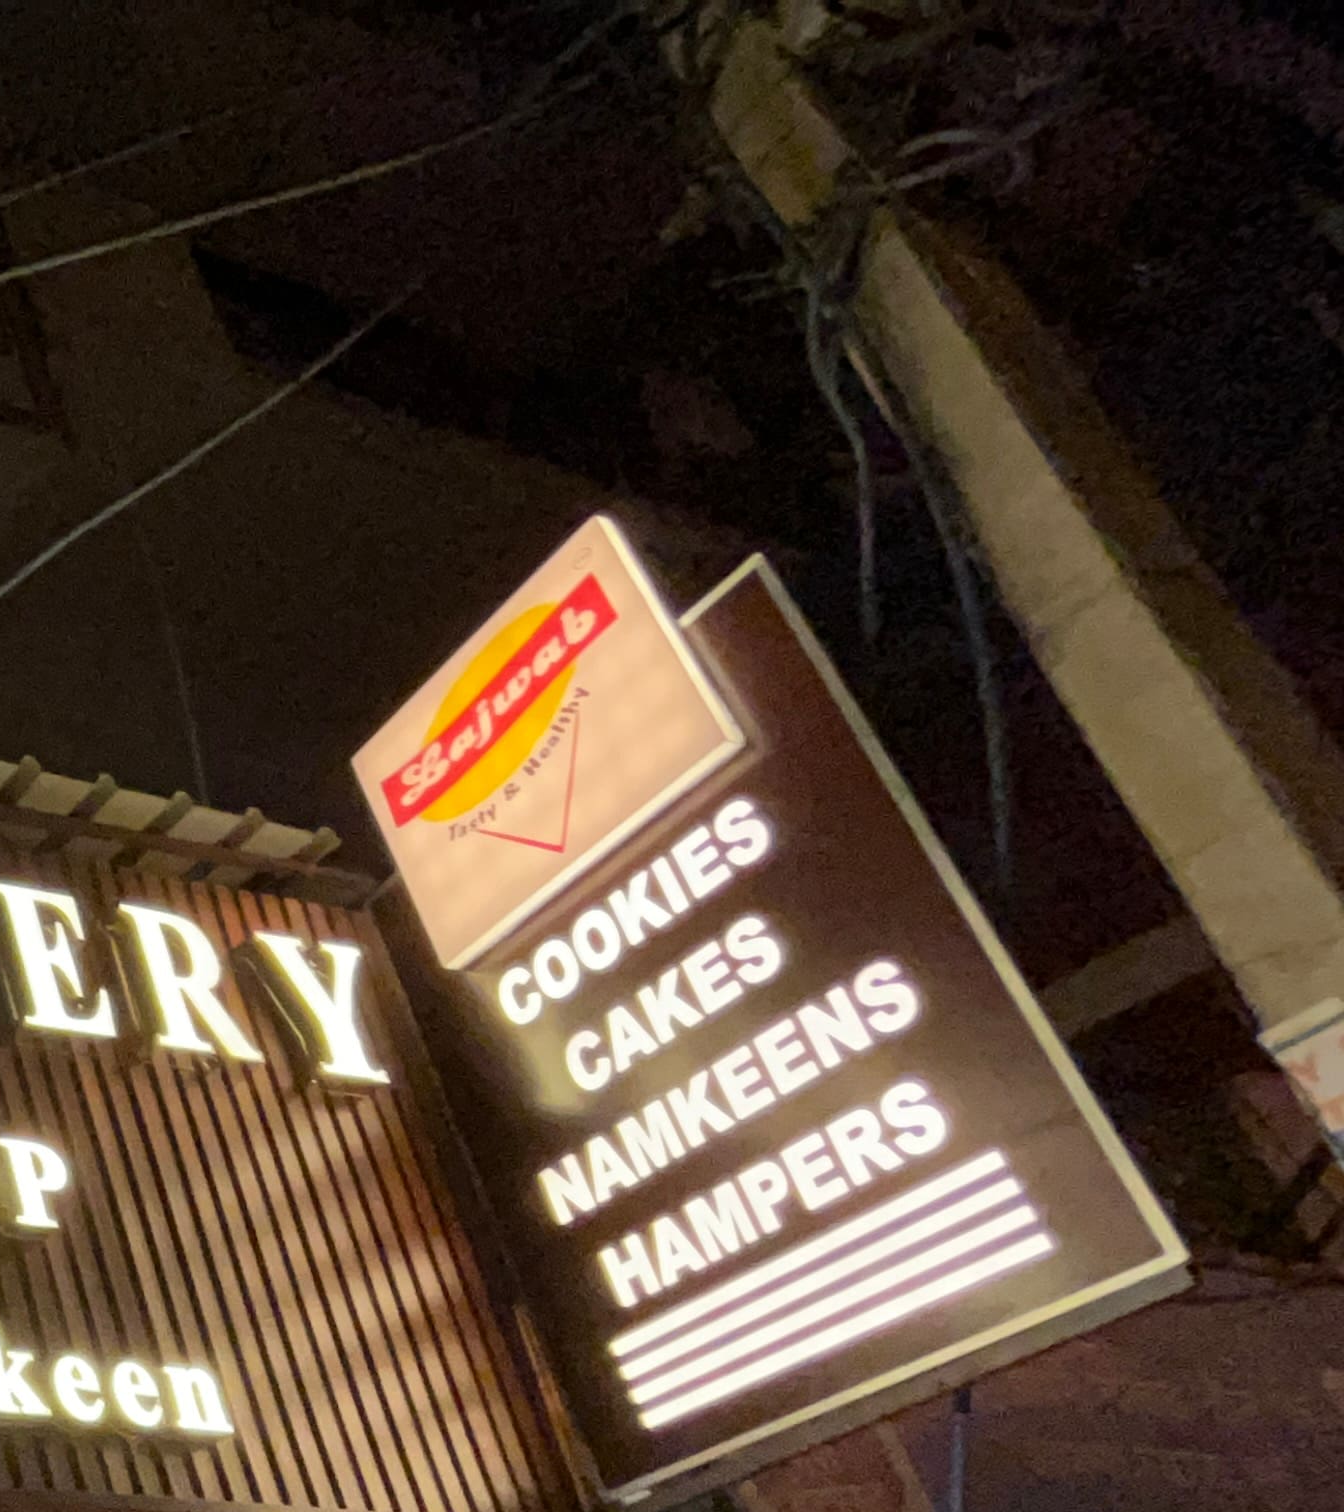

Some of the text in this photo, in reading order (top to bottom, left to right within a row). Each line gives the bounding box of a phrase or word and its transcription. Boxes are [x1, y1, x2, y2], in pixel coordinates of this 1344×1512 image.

[400, 605, 597, 808] Lajwab
[497, 798, 771, 1027] COOKIES
[564, 915, 782, 1093] CAKES
[537, 961, 919, 1227] NAMKEENS
[597, 1081, 948, 1308] HAMPERS
